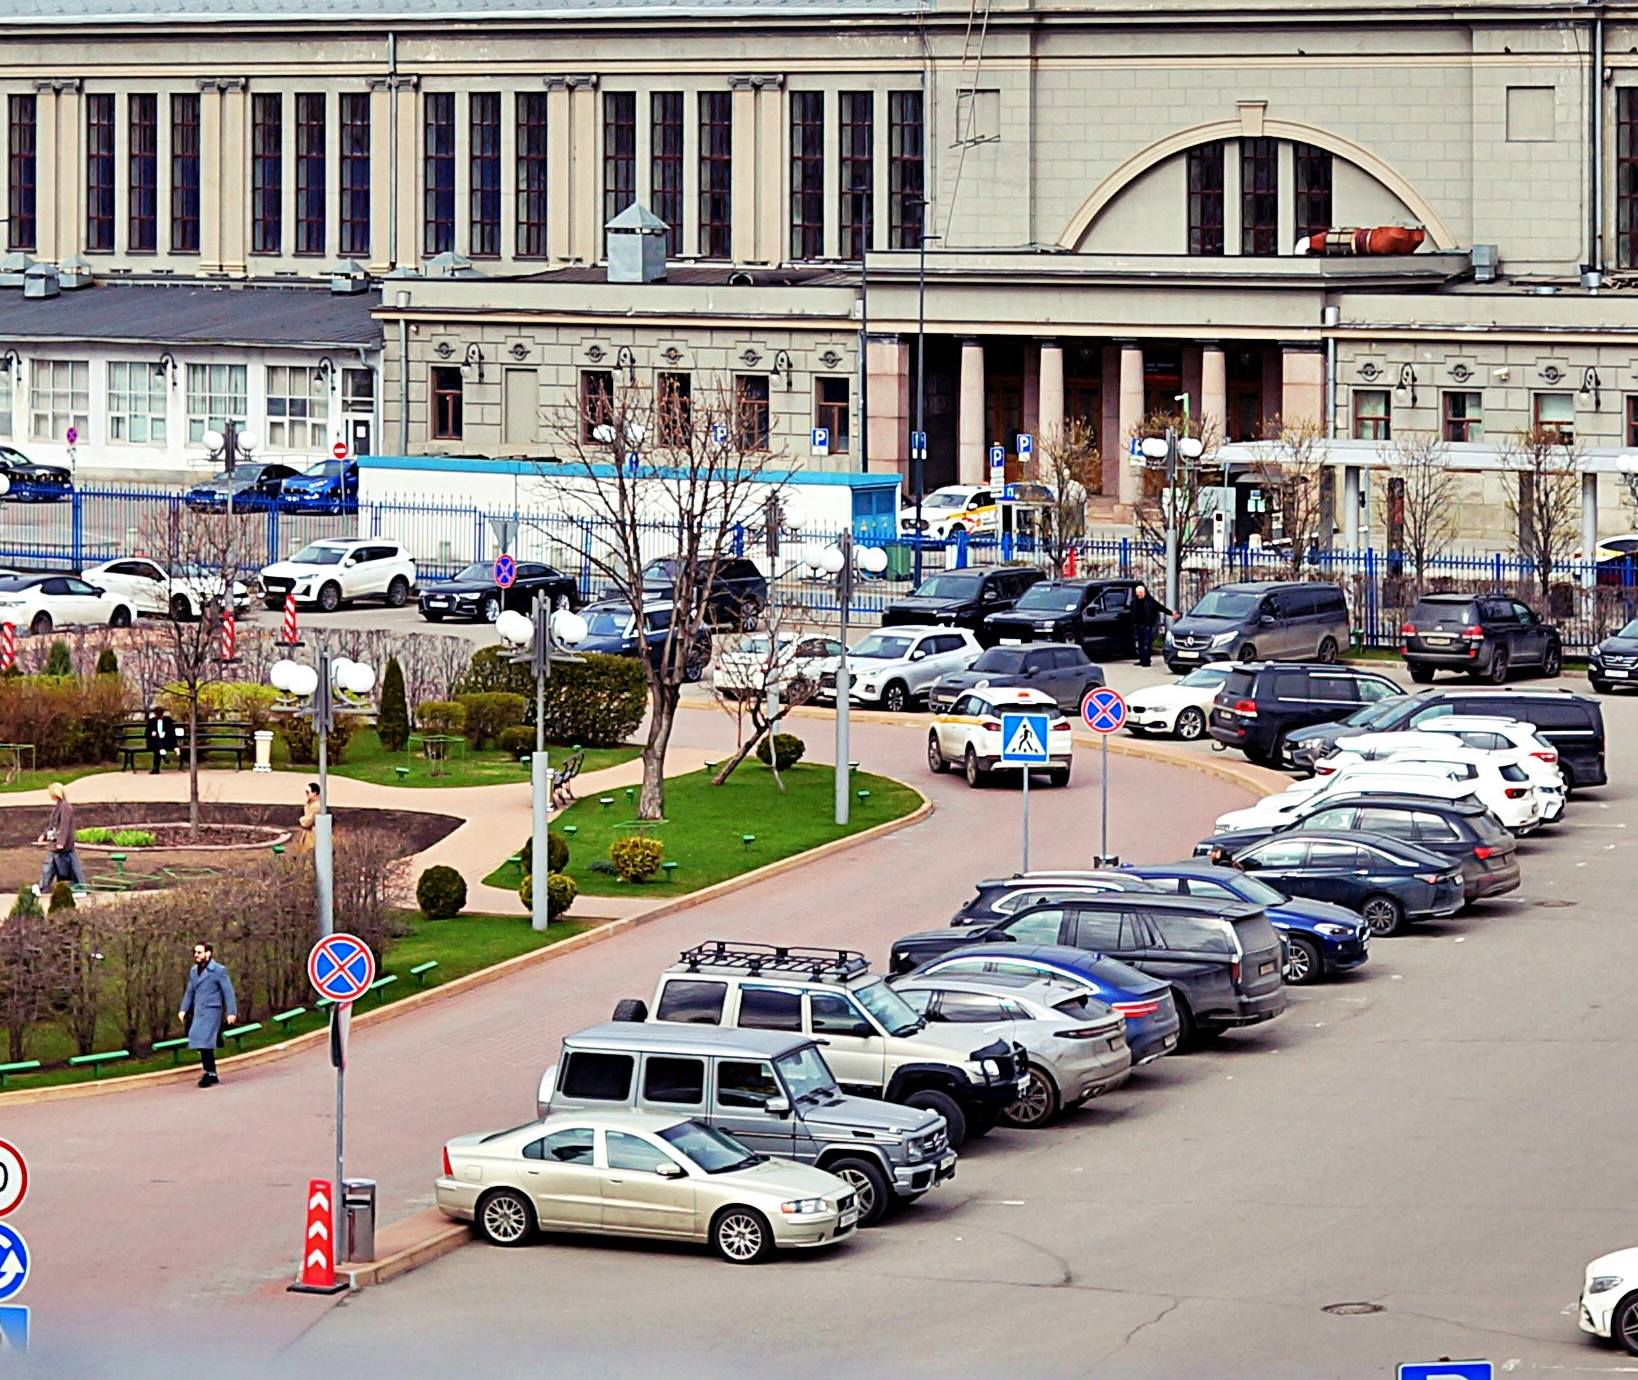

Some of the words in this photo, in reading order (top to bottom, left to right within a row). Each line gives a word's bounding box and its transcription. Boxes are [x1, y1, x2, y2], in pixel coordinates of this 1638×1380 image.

[815, 430, 826, 446] P
[1019, 436, 1029, 452] P
[993, 449, 1002, 466] P
